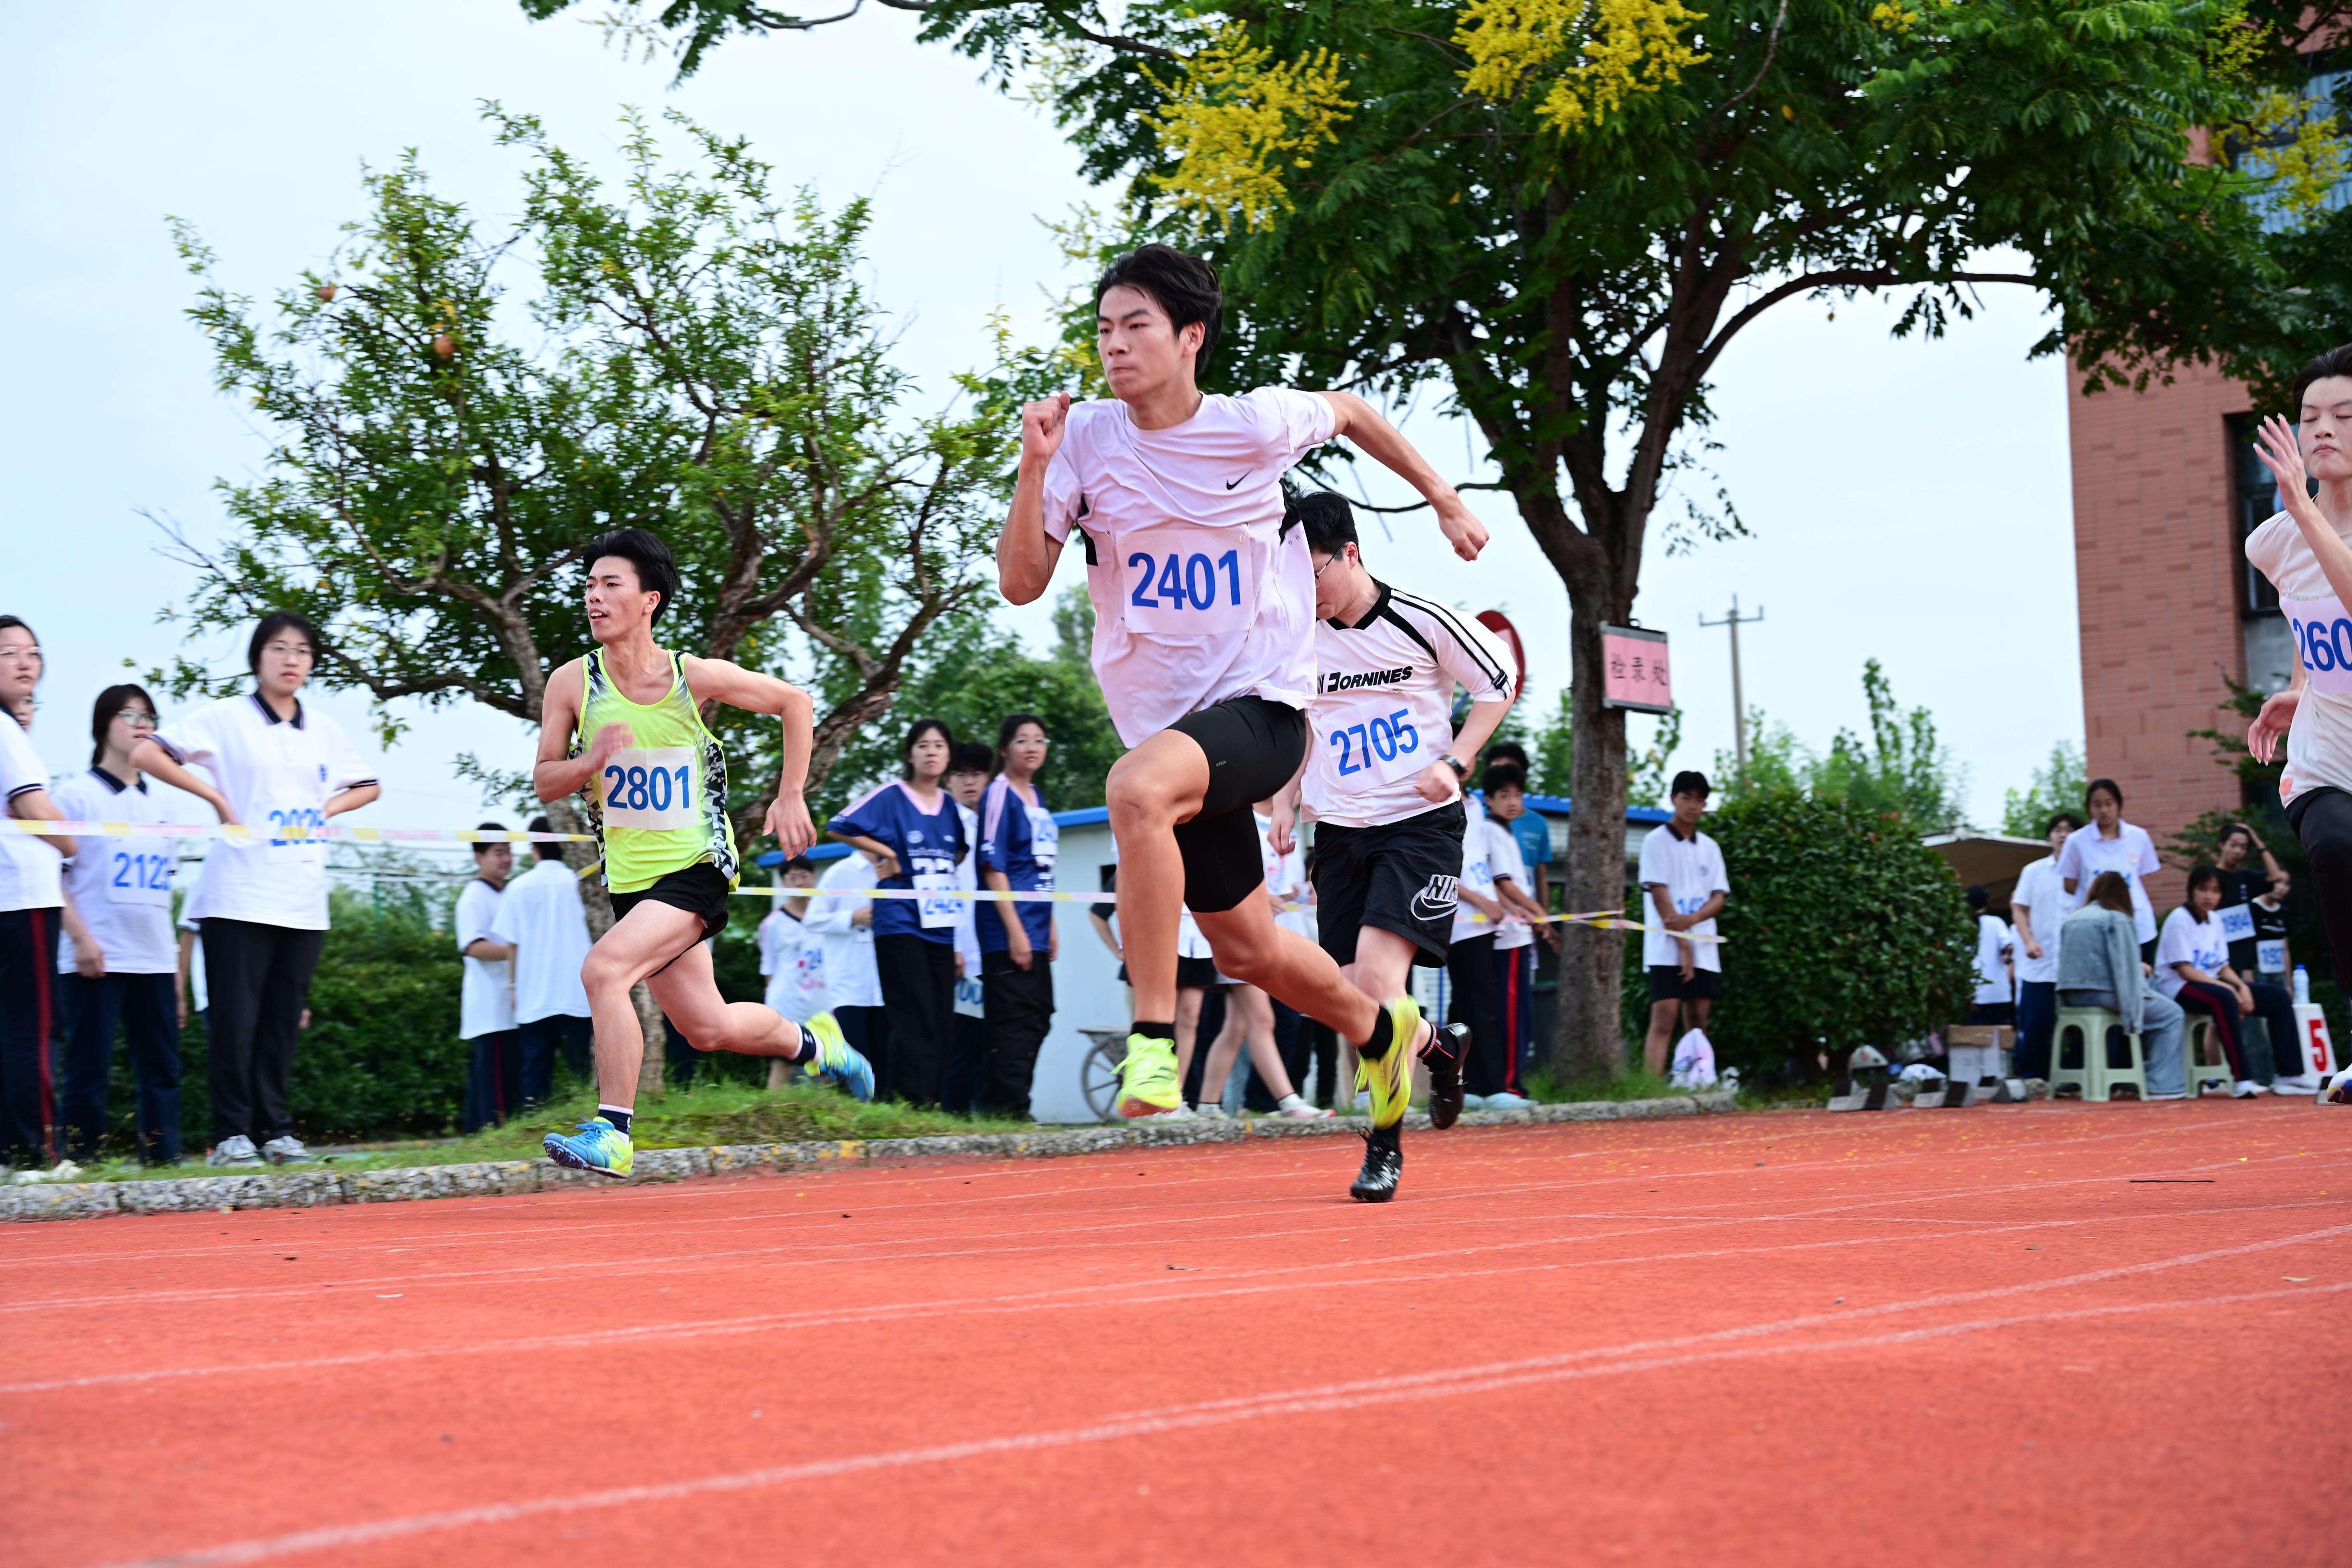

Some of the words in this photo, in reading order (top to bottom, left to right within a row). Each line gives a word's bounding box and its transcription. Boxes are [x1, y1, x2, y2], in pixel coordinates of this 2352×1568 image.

[1129, 550, 1241, 610] 2401
[2293, 618, 2352, 671] 260
[1330, 708, 1418, 777] 2705
[605, 765, 689, 811] 2801
[2308, 1018, 2328, 1073] 5
